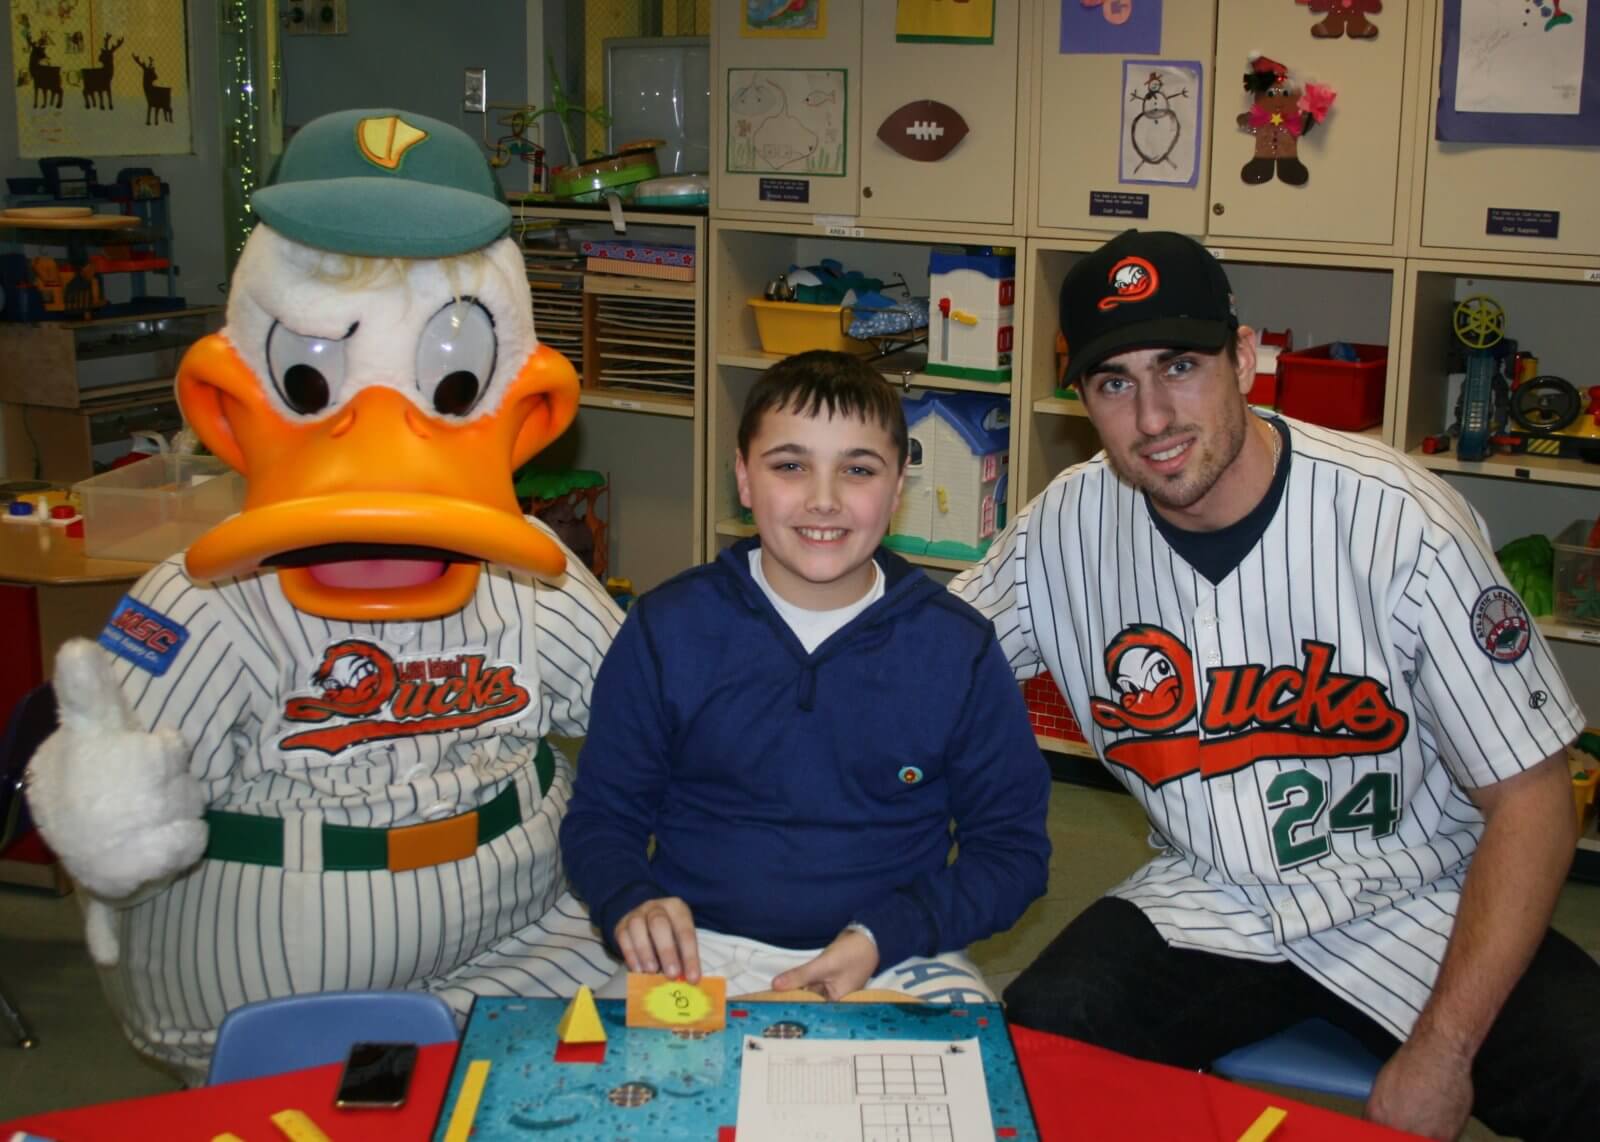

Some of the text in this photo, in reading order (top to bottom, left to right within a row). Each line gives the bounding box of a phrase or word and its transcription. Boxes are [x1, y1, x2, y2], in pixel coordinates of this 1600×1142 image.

[284, 639, 530, 723] Ducks
[1090, 622, 1409, 737] Ducks
[1265, 769, 1398, 872] 24
